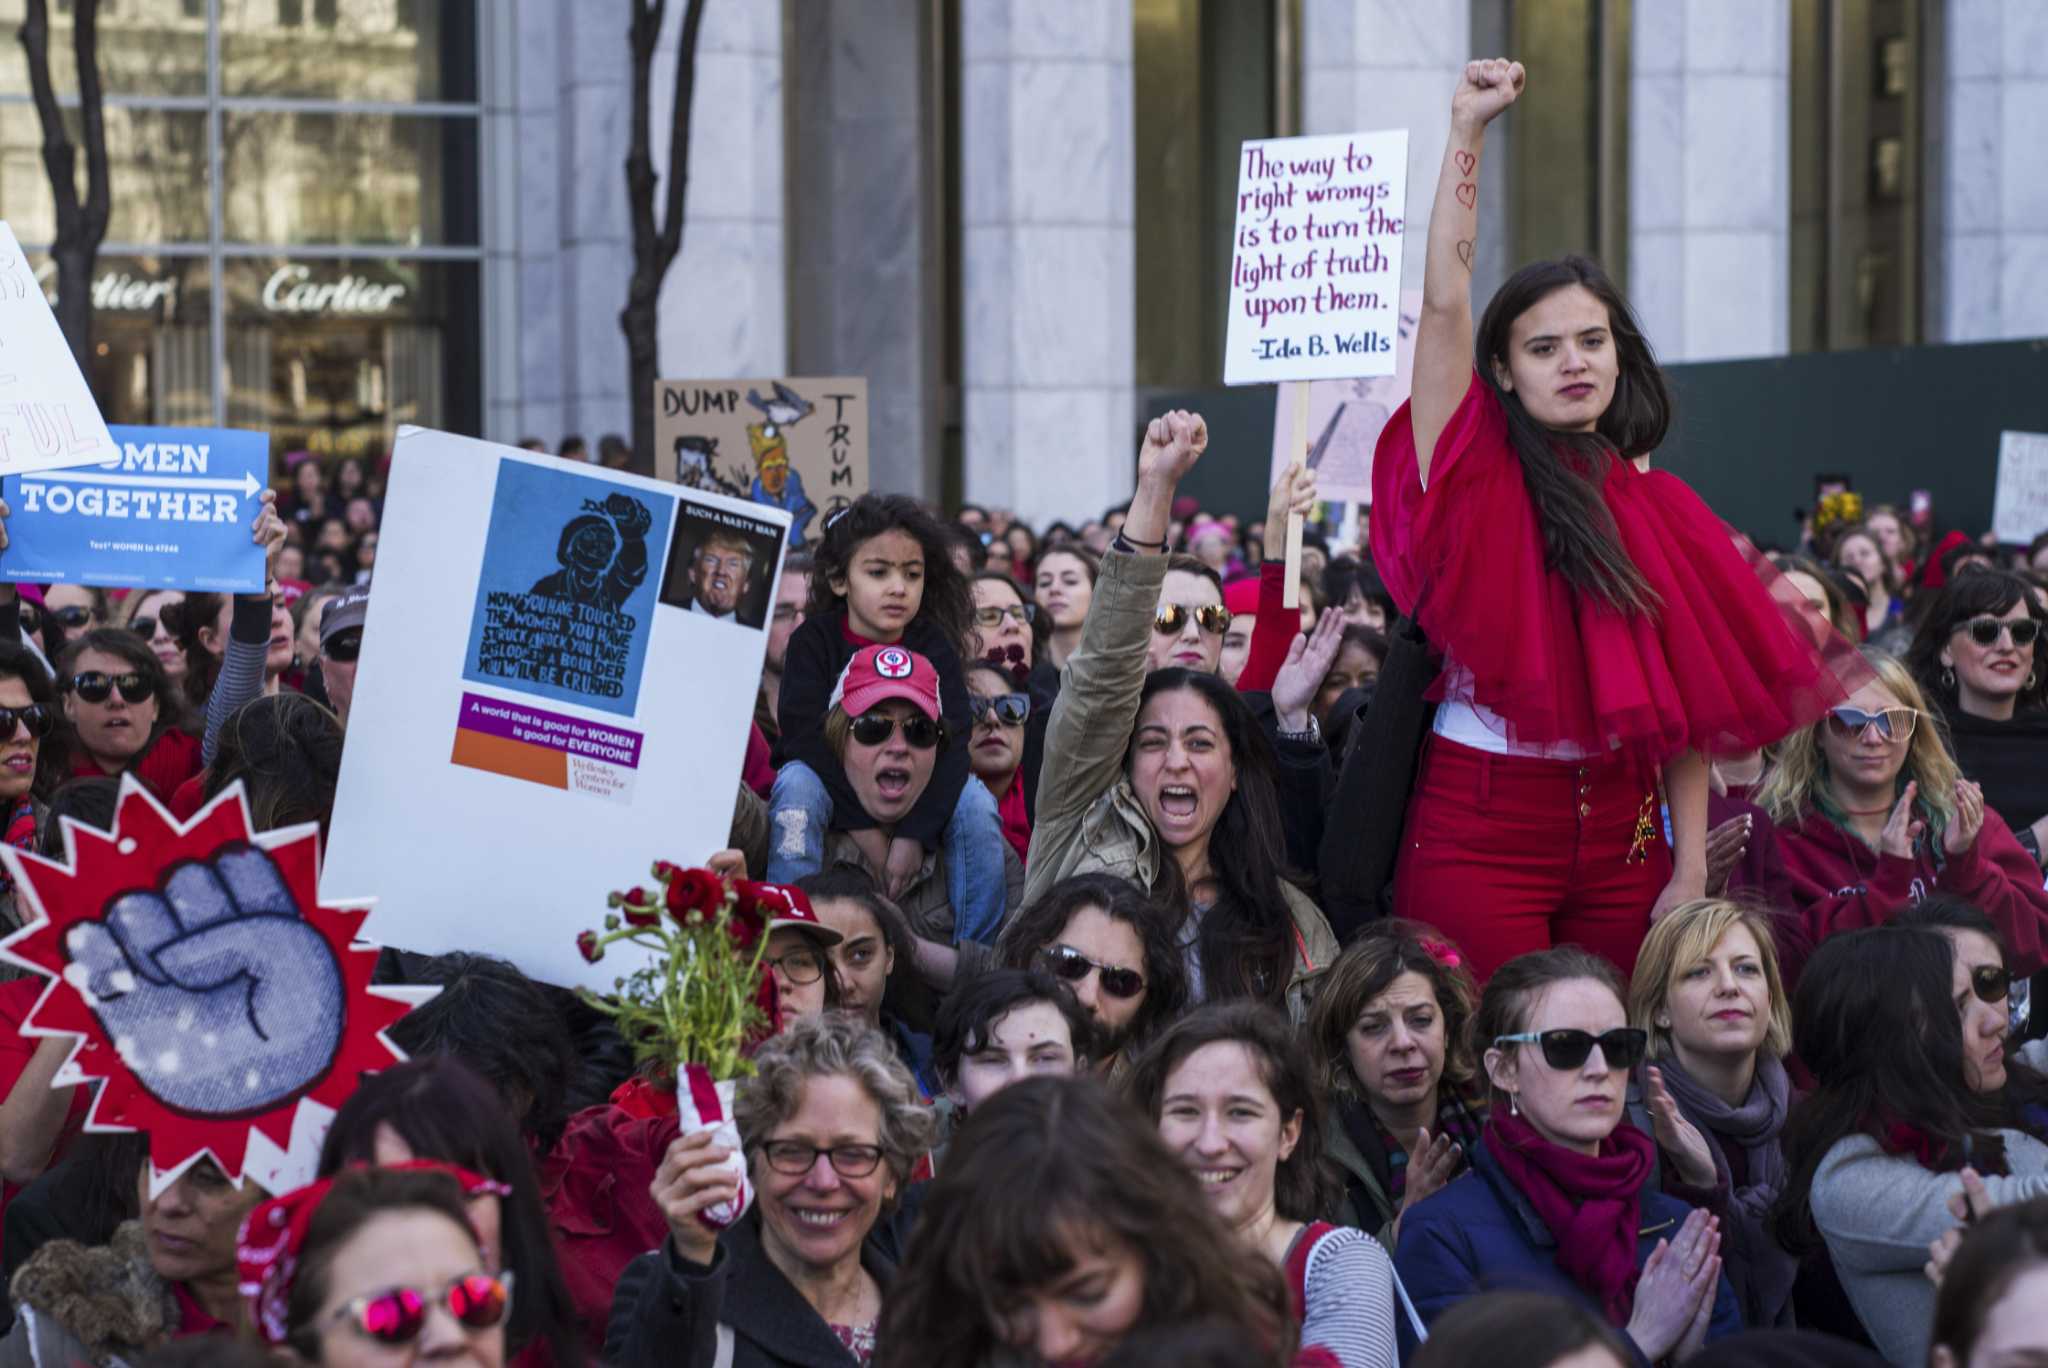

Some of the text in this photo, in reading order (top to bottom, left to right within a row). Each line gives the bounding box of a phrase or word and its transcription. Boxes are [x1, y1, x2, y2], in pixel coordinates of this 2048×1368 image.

[1244, 141, 1373, 185] The way to
[1240, 181, 1390, 222] right wrongs
[1239, 206, 1404, 248] is to turn the
[1234, 243, 1388, 293] light of truth
[262, 264, 405, 313] Cartier
[1245, 282, 1388, 329] upon them.
[1308, 334, 1330, 357] B.
[1334, 331, 1391, 355] Wells
[663, 387, 739, 416] DUMP
[100, 442, 210, 473] MEN
[20, 483, 238, 523] TOGETHER
[686, 505, 778, 538] SUCH A NASTY MAN
[112, 541, 144, 553] WOMEN
[145, 543, 153, 552] to
[485, 607, 633, 648] THE WOMEN YOU HAVE
[487, 591, 521, 609] NOW
[522, 592, 547, 612] YOU
[578, 602, 636, 632] TOUCHED
[484, 625, 529, 643] STRUCK
[570, 639, 593, 657] YOU
[538, 665, 557, 684] BE
[562, 669, 624, 698] CRUSHED
[560, 652, 626, 680] BOULDER
[471, 703, 636, 749] A world that is good for WOMEN
[512, 725, 633, 763] is good for EVERYONE
[572, 758, 615, 777] Wellesley
[573, 770, 611, 786] Centers
[574, 779, 612, 796] Women
